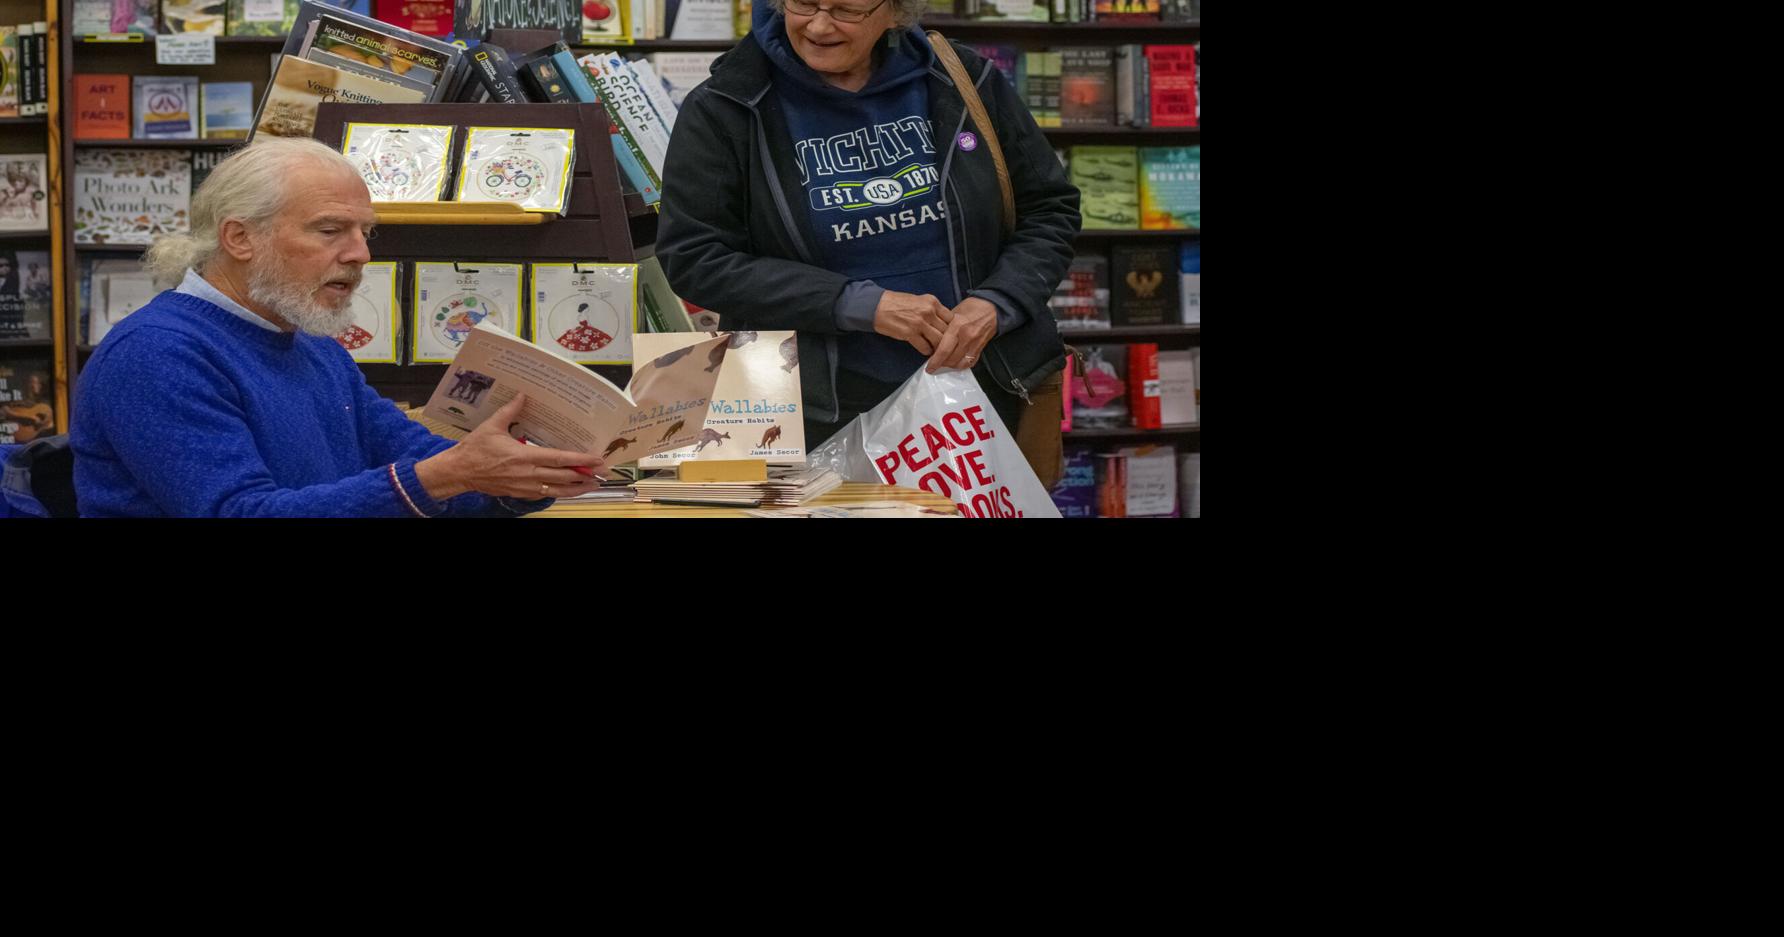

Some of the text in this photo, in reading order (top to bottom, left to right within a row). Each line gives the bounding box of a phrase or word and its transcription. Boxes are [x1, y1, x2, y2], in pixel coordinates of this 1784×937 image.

[324, 24, 438, 67] knitted animal scarves
[89, 84, 115, 94] ART
[307, 80, 339, 96] Vogue
[596, 77, 621, 112] BIRD
[81, 110, 125, 121] FACTS
[795, 115, 936, 186] ICHIT
[84, 177, 180, 196] Photo Ark
[821, 188, 860, 206] EST.
[867, 183, 899, 200] USA
[90, 197, 174, 214] Wonders
[629, 399, 706, 425] Wallabies
[708, 399, 797, 414] Wallabies
[747, 417, 775, 425] Habits
[875, 405, 995, 486] PEACE.
[918, 450, 996, 499] OVE.
[955, 486, 1024, 518] OKS.
